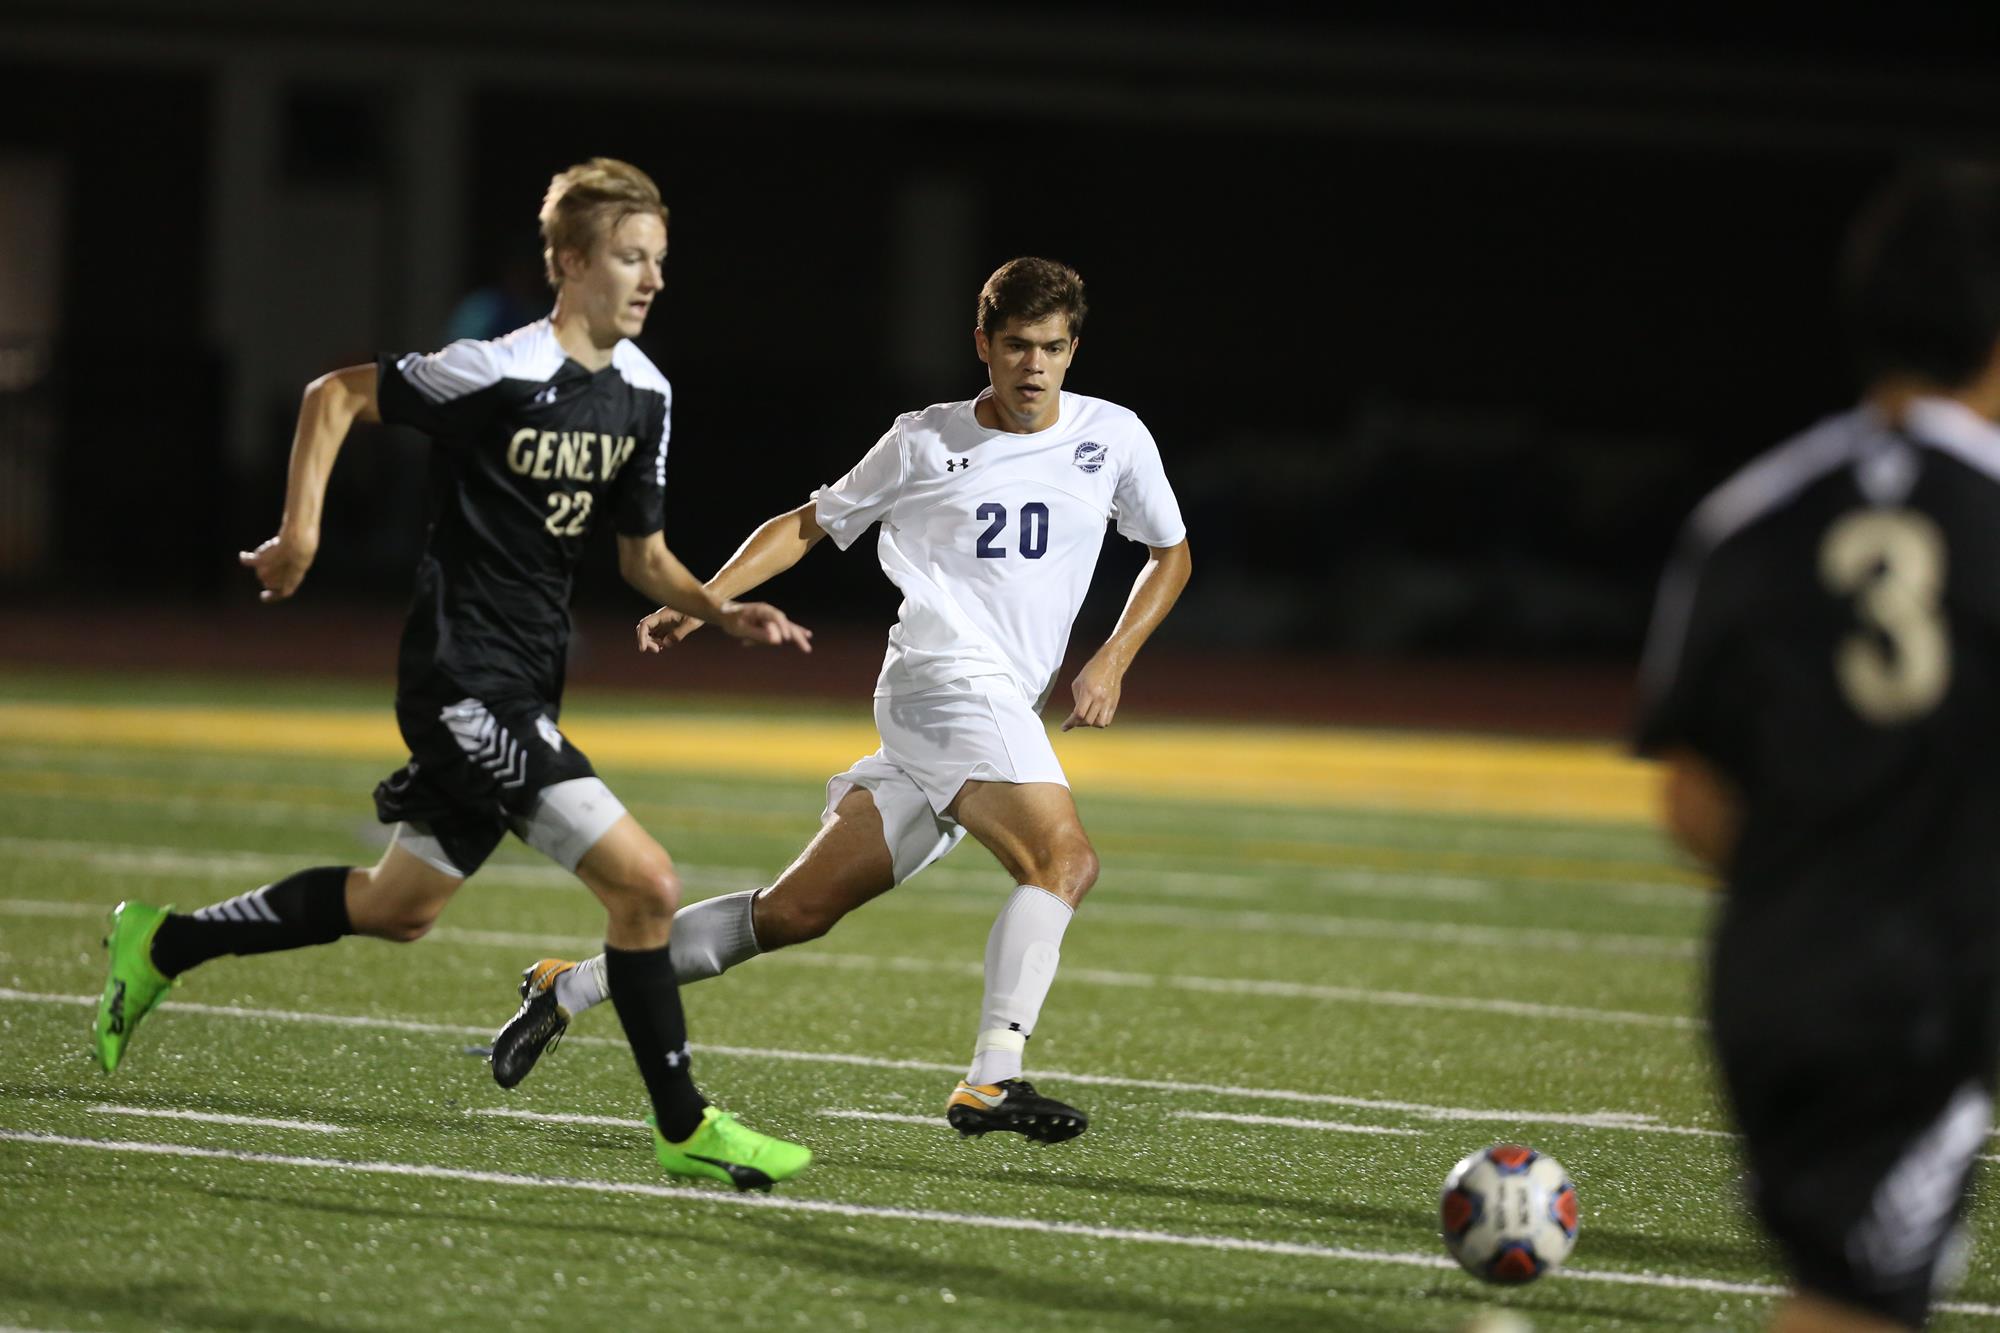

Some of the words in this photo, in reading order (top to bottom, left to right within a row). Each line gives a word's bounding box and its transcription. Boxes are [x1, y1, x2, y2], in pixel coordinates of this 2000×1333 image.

[545, 490, 593, 537] 22
[976, 502, 1049, 559] 20
[1820, 508, 1950, 720] 3
